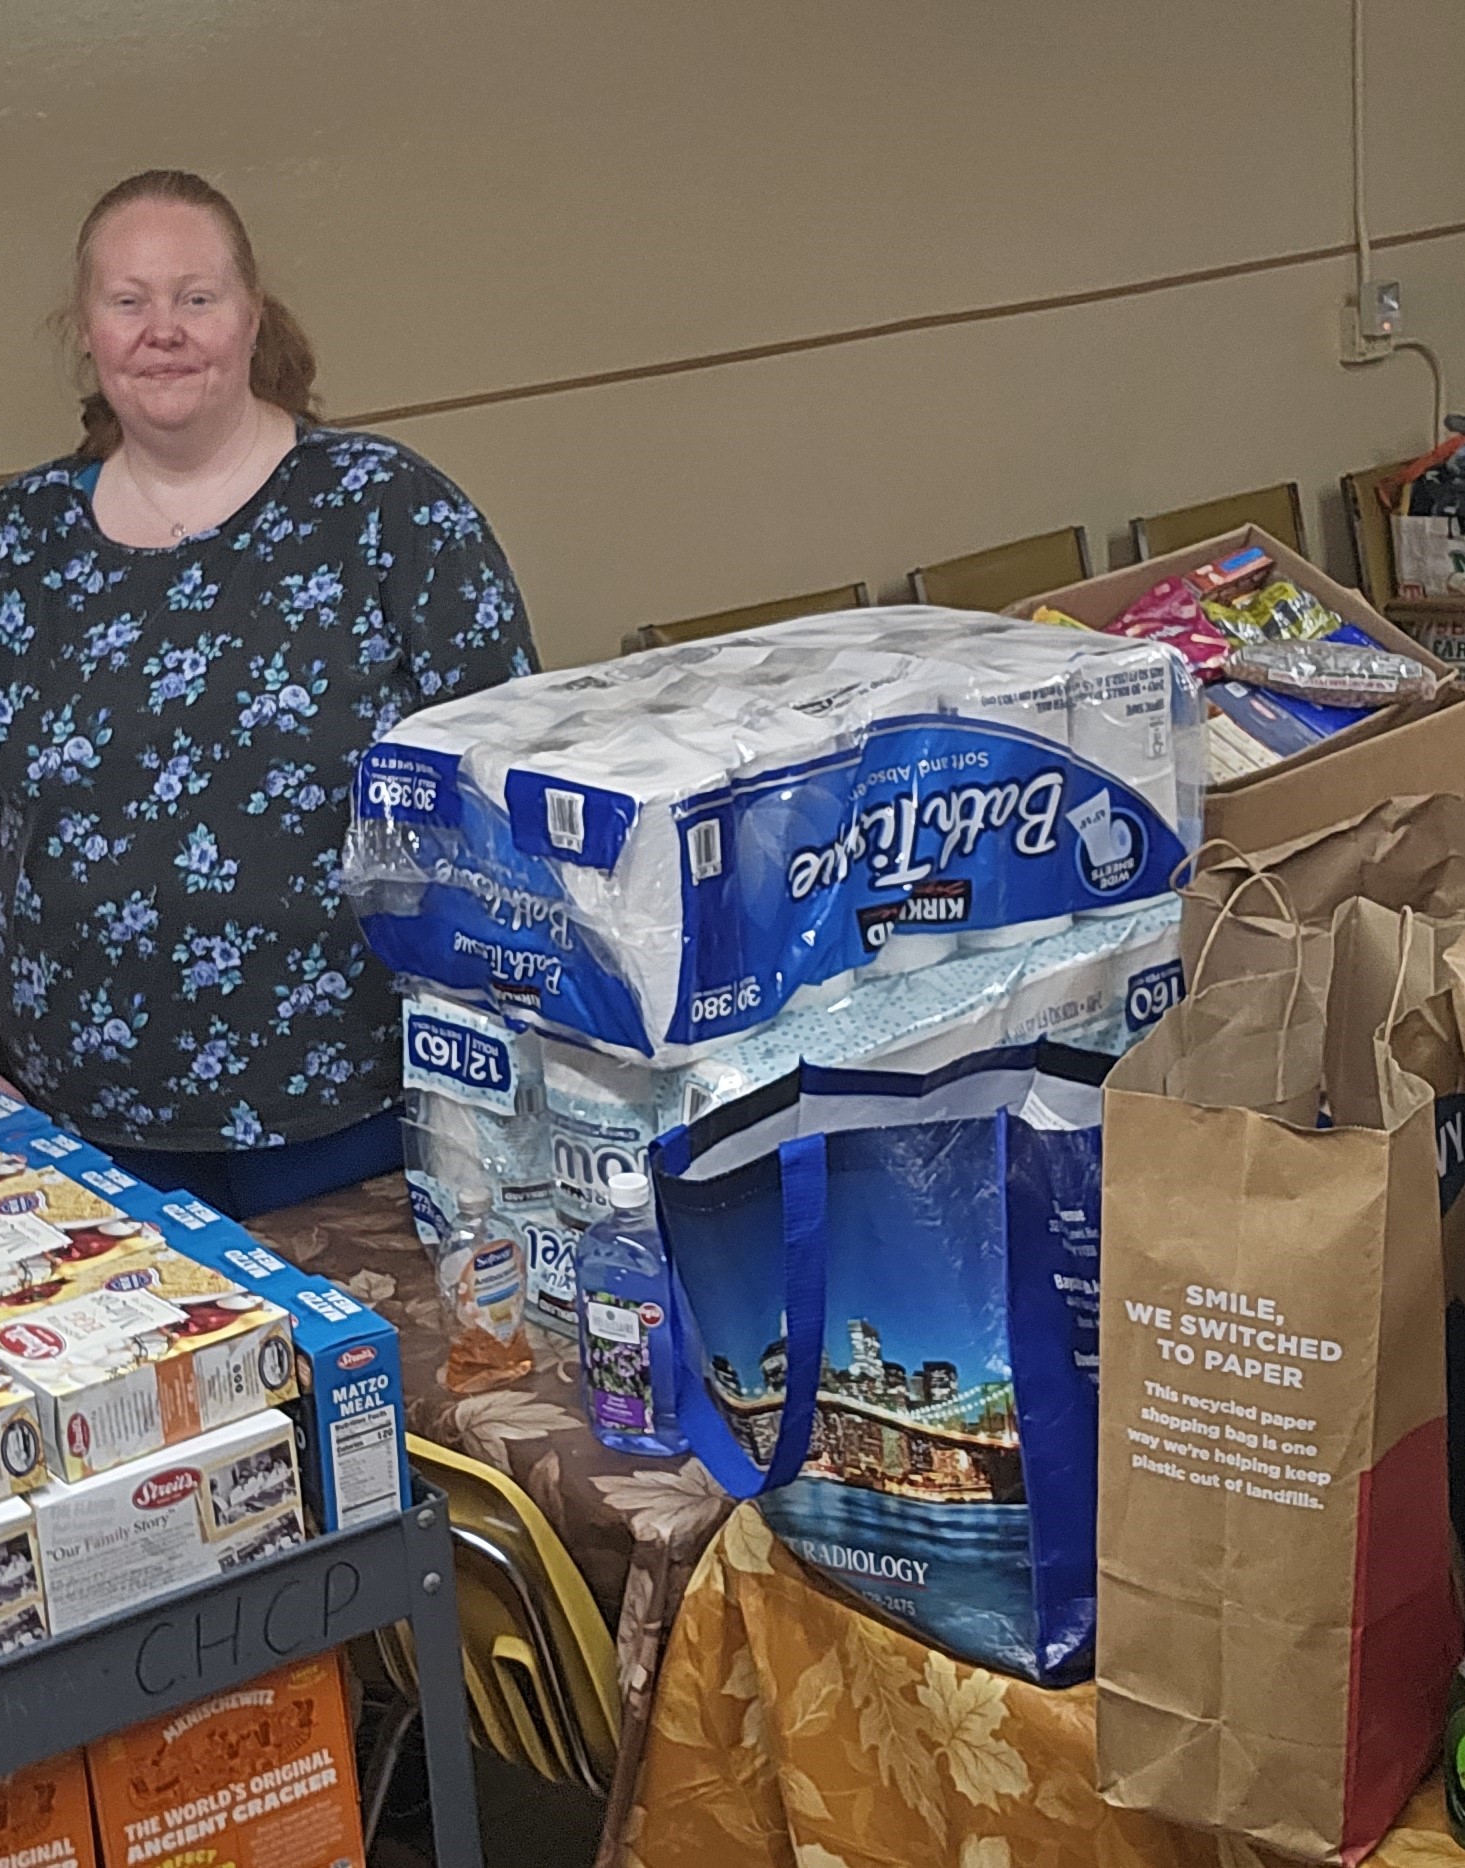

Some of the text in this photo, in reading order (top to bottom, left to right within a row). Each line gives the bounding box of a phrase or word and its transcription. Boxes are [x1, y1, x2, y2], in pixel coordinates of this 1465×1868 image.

[918, 757, 949, 778] and
[951, 751, 989, 771] Soft
[368, 781, 437, 812] 30 380
[788, 771, 1065, 899] Bath Tiue
[1100, 870, 1130, 890] WIDE
[503, 887, 573, 951] Bath
[453, 930, 563, 995] Bath Tissue
[691, 984, 762, 1023] 30 380
[1129, 975, 1182, 1021] 160
[414, 1030, 504, 1083] 12 160
[1124, 1299, 1173, 1330] WE
[1179, 1314, 1343, 1363] SWITCHED
[1185, 1284, 1286, 1327] SMILE,
[331, 1374, 389, 1404] MATZO
[1156, 1337, 1304, 1389] TO PAPER
[339, 1391, 385, 1417] MEAL
[1140, 1404, 1318, 1457] shopping bag is one
[1143, 1379, 1318, 1434] This recycled paper
[1126, 1425, 1332, 1487] way we're helping keep
[1131, 1453, 1325, 1511] plastic out of landfills.
[45, 1545, 82, 1562] "Our
[83, 1526, 131, 1552] Family
[133, 1507, 176, 1534] Story"
[801, 1540, 929, 1586] RADIOLOGY
[162, 1689, 275, 1745] MANISCHEWITZ
[123, 1747, 334, 1843] THE WORLD'S ORIGINAL
[126, 1811, 229, 1867] ANCIENT
[232, 1767, 338, 1824] CRACKER
